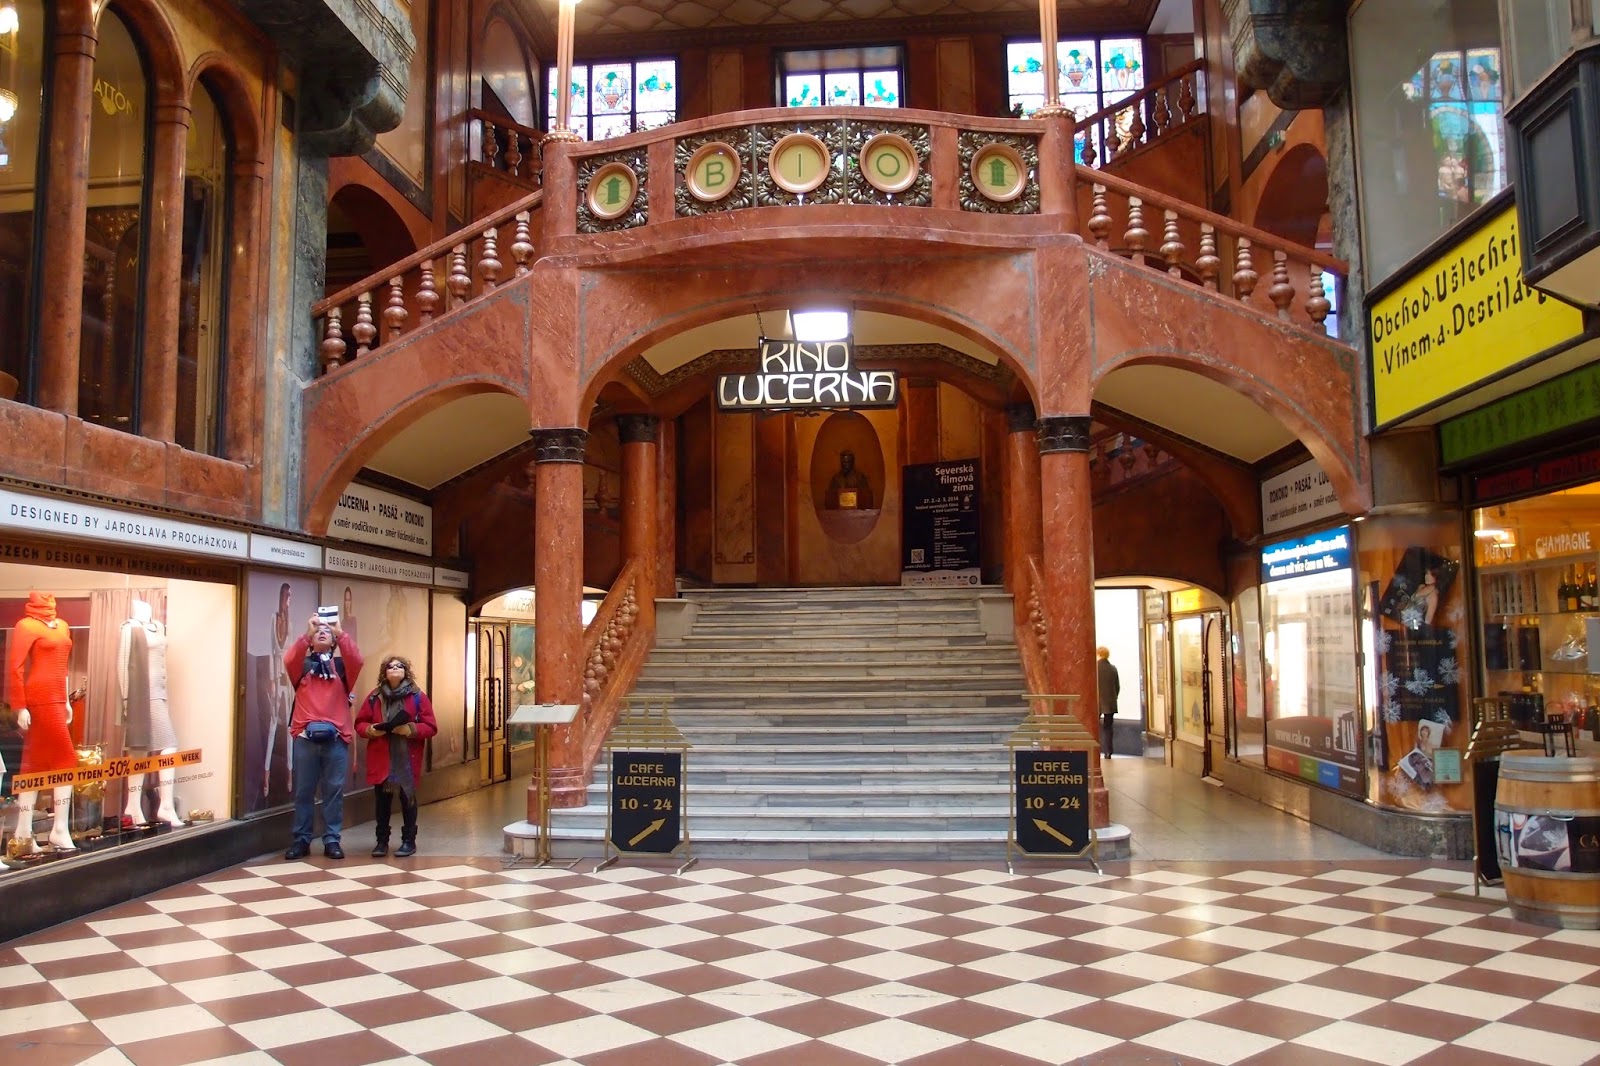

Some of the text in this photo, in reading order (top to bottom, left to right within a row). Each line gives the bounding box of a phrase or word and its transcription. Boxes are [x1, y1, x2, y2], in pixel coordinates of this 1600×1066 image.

[1373, 286, 1430, 344] Obchod
[762, 342, 849, 373] KINO
[1384, 333, 1431, 374] Vínem
[719, 371, 896, 406] LUCERNA
[935, 464, 974, 476] Severská
[940, 474, 974, 485] filmová
[952, 483, 974, 492] zima
[338, 494, 425, 528] LUCERNA PASÁŽ ROKOKO
[11, 503, 238, 550] DESIGNED BY JAROSLAVA PROCHÁZKOVÁ
[1535, 531, 1592, 554] CHAMPAGNE
[46, 550, 90, 565] DESIGN
[96, 555, 122, 569] WITH
[329, 556, 358, 569] DESIGNED
[360, 561, 367, 570] BY
[368, 563, 398, 575] JAROSLAVA
[13, 751, 200, 790] POUZE TENTO TÝDEN -50% ONLY THIS WEEK
[629, 763, 664, 774] CAFE
[1033, 761, 1070, 772] CAFE
[617, 776, 676, 787] LUCERNA
[1020, 774, 1084, 785] LUCERNA
[620, 798, 638, 810] 10
[653, 798, 673, 811] 24
[1024, 797, 1044, 809] 10
[1059, 797, 1080, 809] 24
